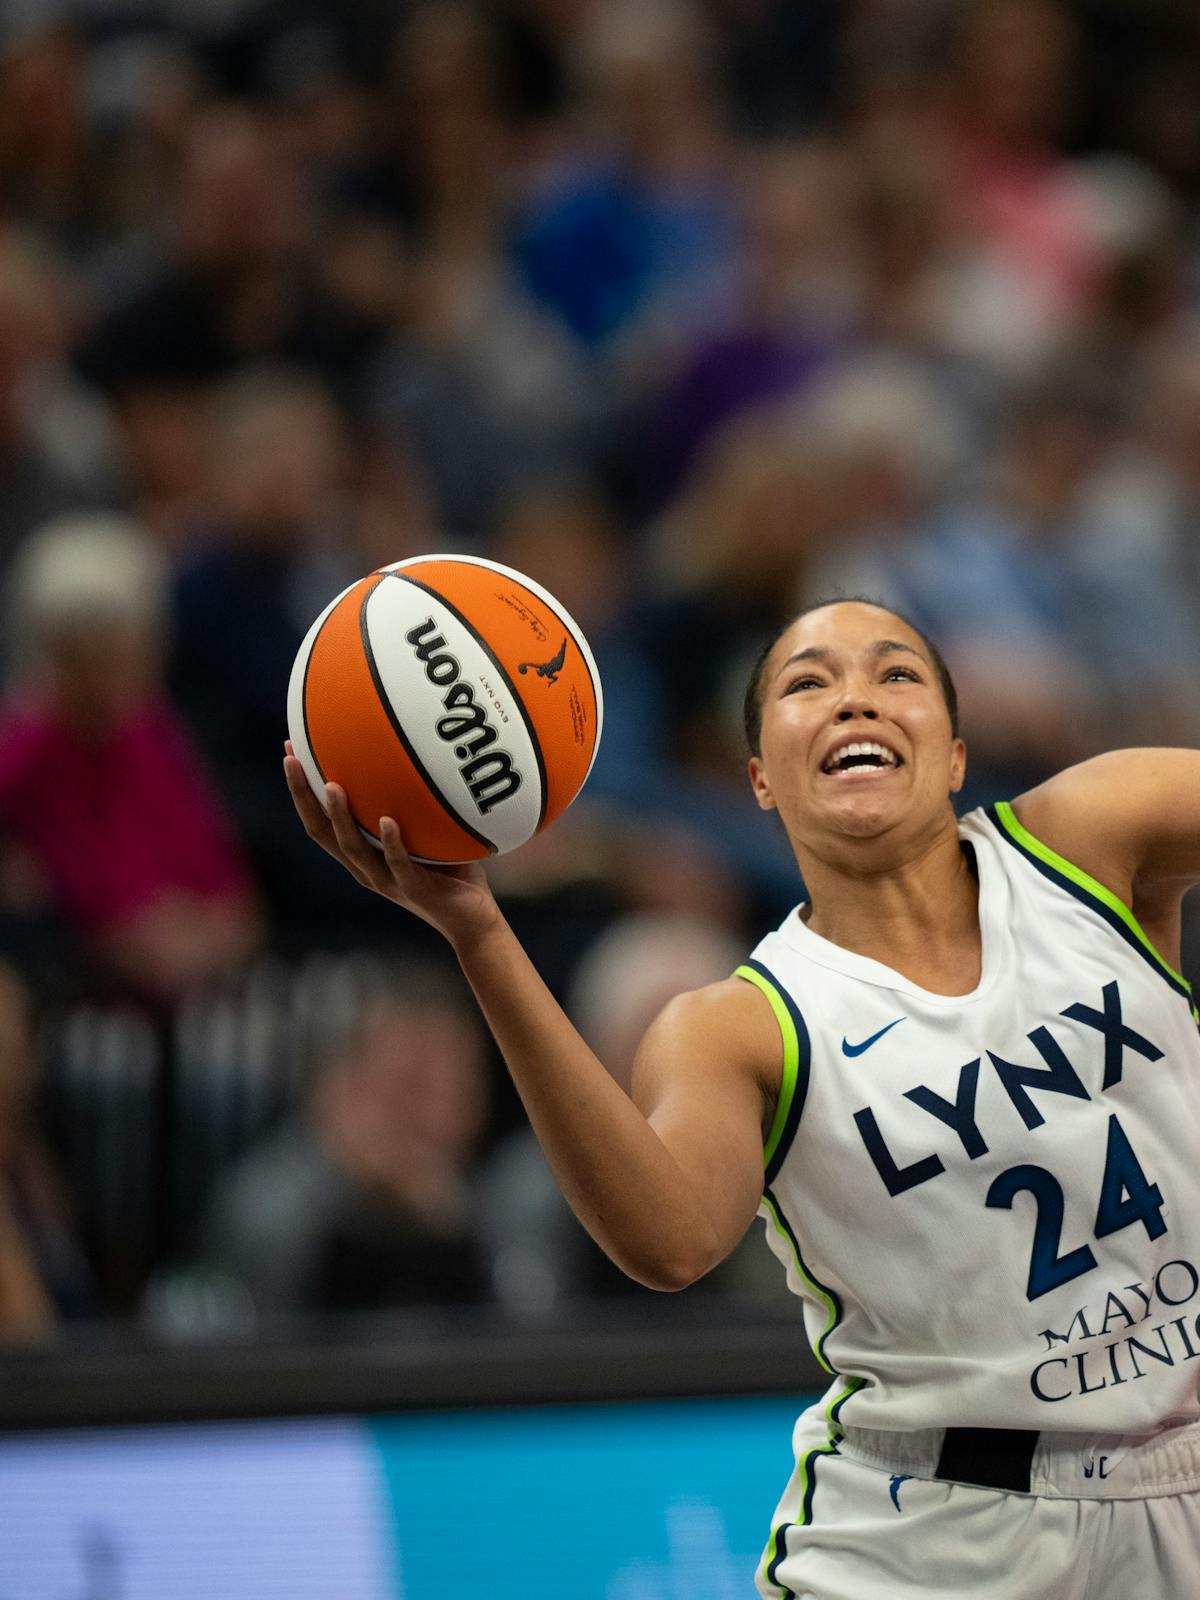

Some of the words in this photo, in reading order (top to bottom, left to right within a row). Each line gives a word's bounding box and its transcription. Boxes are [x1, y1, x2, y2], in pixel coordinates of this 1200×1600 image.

[405, 615, 523, 816] Wilson
[480, 676, 495, 698] NXT
[494, 701, 509, 723] EVO
[853, 980, 1165, 1198] LYNX
[985, 1114, 1168, 1301] 24
[1038, 1260, 1199, 1351] MAYO
